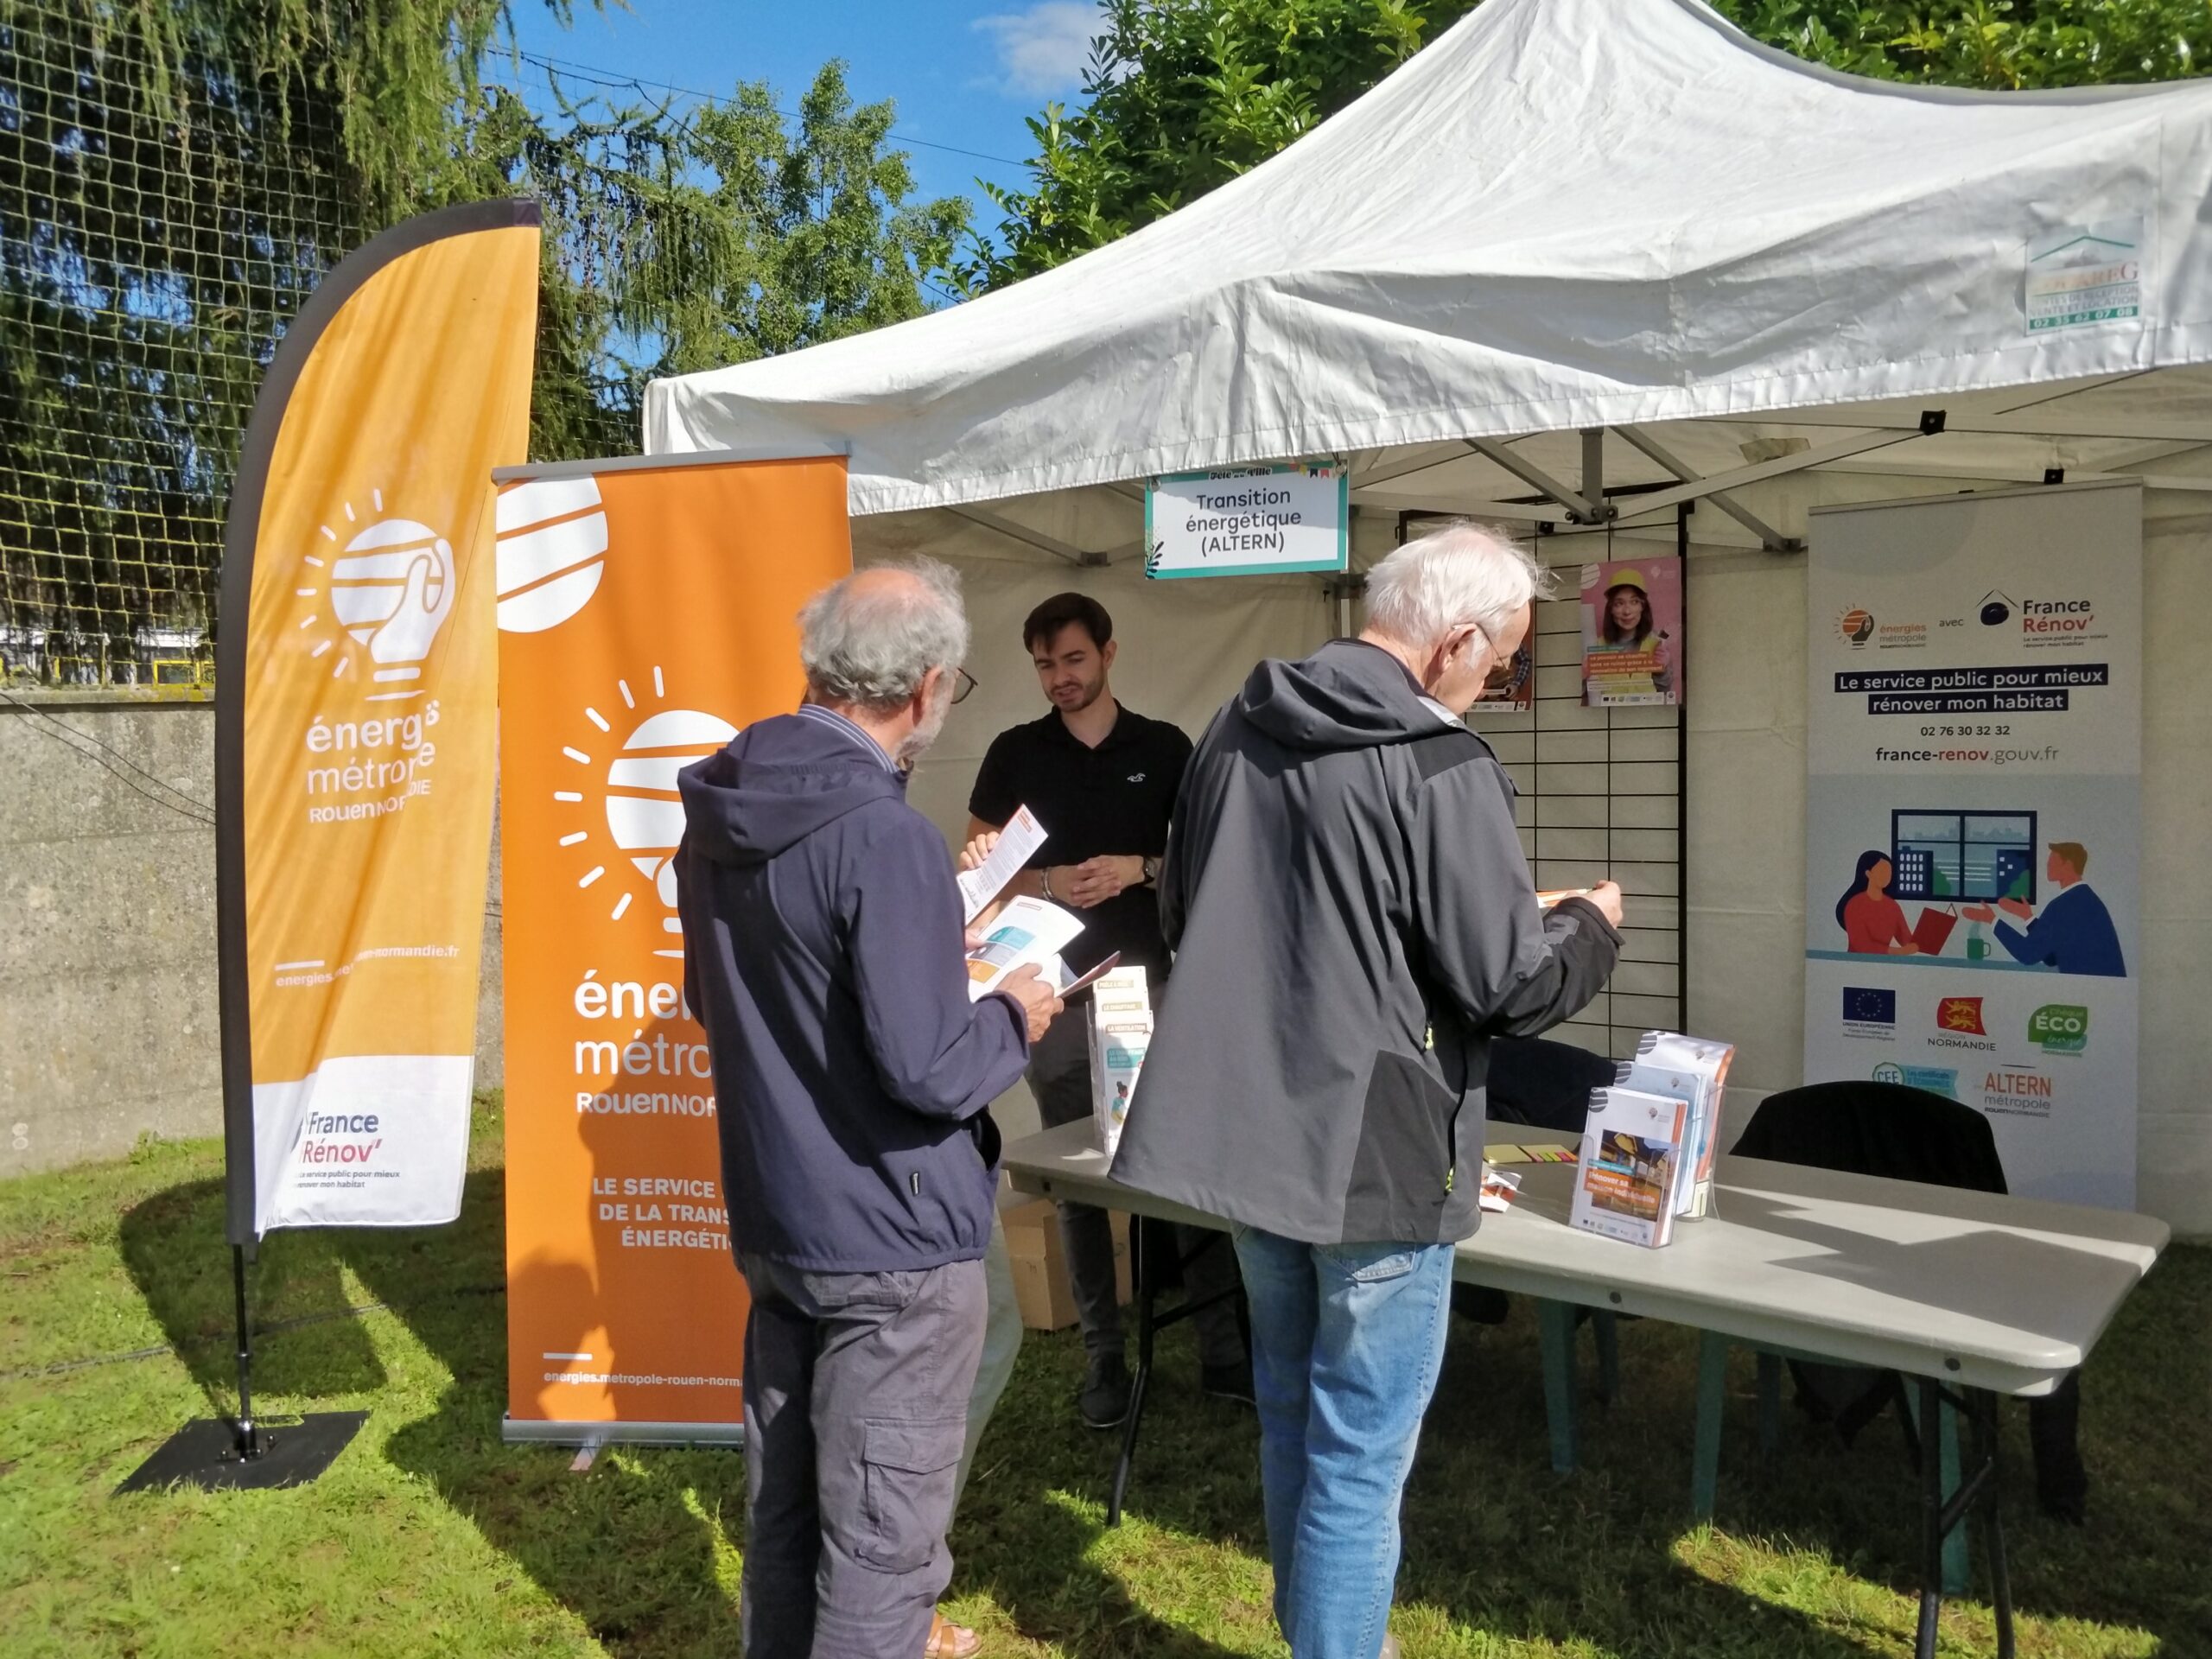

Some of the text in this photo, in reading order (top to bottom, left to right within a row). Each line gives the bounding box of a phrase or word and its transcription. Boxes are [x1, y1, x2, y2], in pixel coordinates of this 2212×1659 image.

[2033, 319, 2050, 328] 02
[2075, 313, 2090, 323] 62
[2095, 310, 2111, 321] 07
[2117, 308, 2133, 318] 08
[1197, 487, 1291, 511] Transition
[1185, 511, 1301, 534] énergétique
[1201, 531, 1285, 557] (ALTERN)
[2023, 600, 2091, 614] France
[1879, 618, 1964, 634] énergies avec
[2023, 614, 2094, 633] Rénov'
[1879, 632, 1927, 643] métropole
[1840, 668, 2103, 692] Le service public pour mieux
[1872, 694, 2063, 711] rénover mon habitat
[1921, 725, 2011, 736] 02 76 30 32 32
[1876, 746, 2059, 765] france-renov.gouv.fr
[2036, 1012, 2082, 1033] ÉCO
[575, 1028, 712, 1078] métro
[1928, 1038, 1997, 1052] NORMANDIE
[1878, 1071, 1899, 1084] CEE
[1985, 1071, 2051, 1096] ALTERN
[1985, 1095, 2051, 1109] métropole
[308, 1111, 379, 1135] France
[302, 1138, 383, 1163] Rénov'
[327, 1169, 351, 1179] public
[373, 1169, 400, 1178] mieux
[337, 1179, 365, 1188] habitat
[593, 1178, 715, 1198] LE SERVICE
[600, 1204, 628, 1221] DE
[635, 1204, 662, 1221] LA
[621, 1225, 732, 1250] ÉNERGÉTI
[544, 1371, 743, 1388] energies.metropole-rouen-norm
